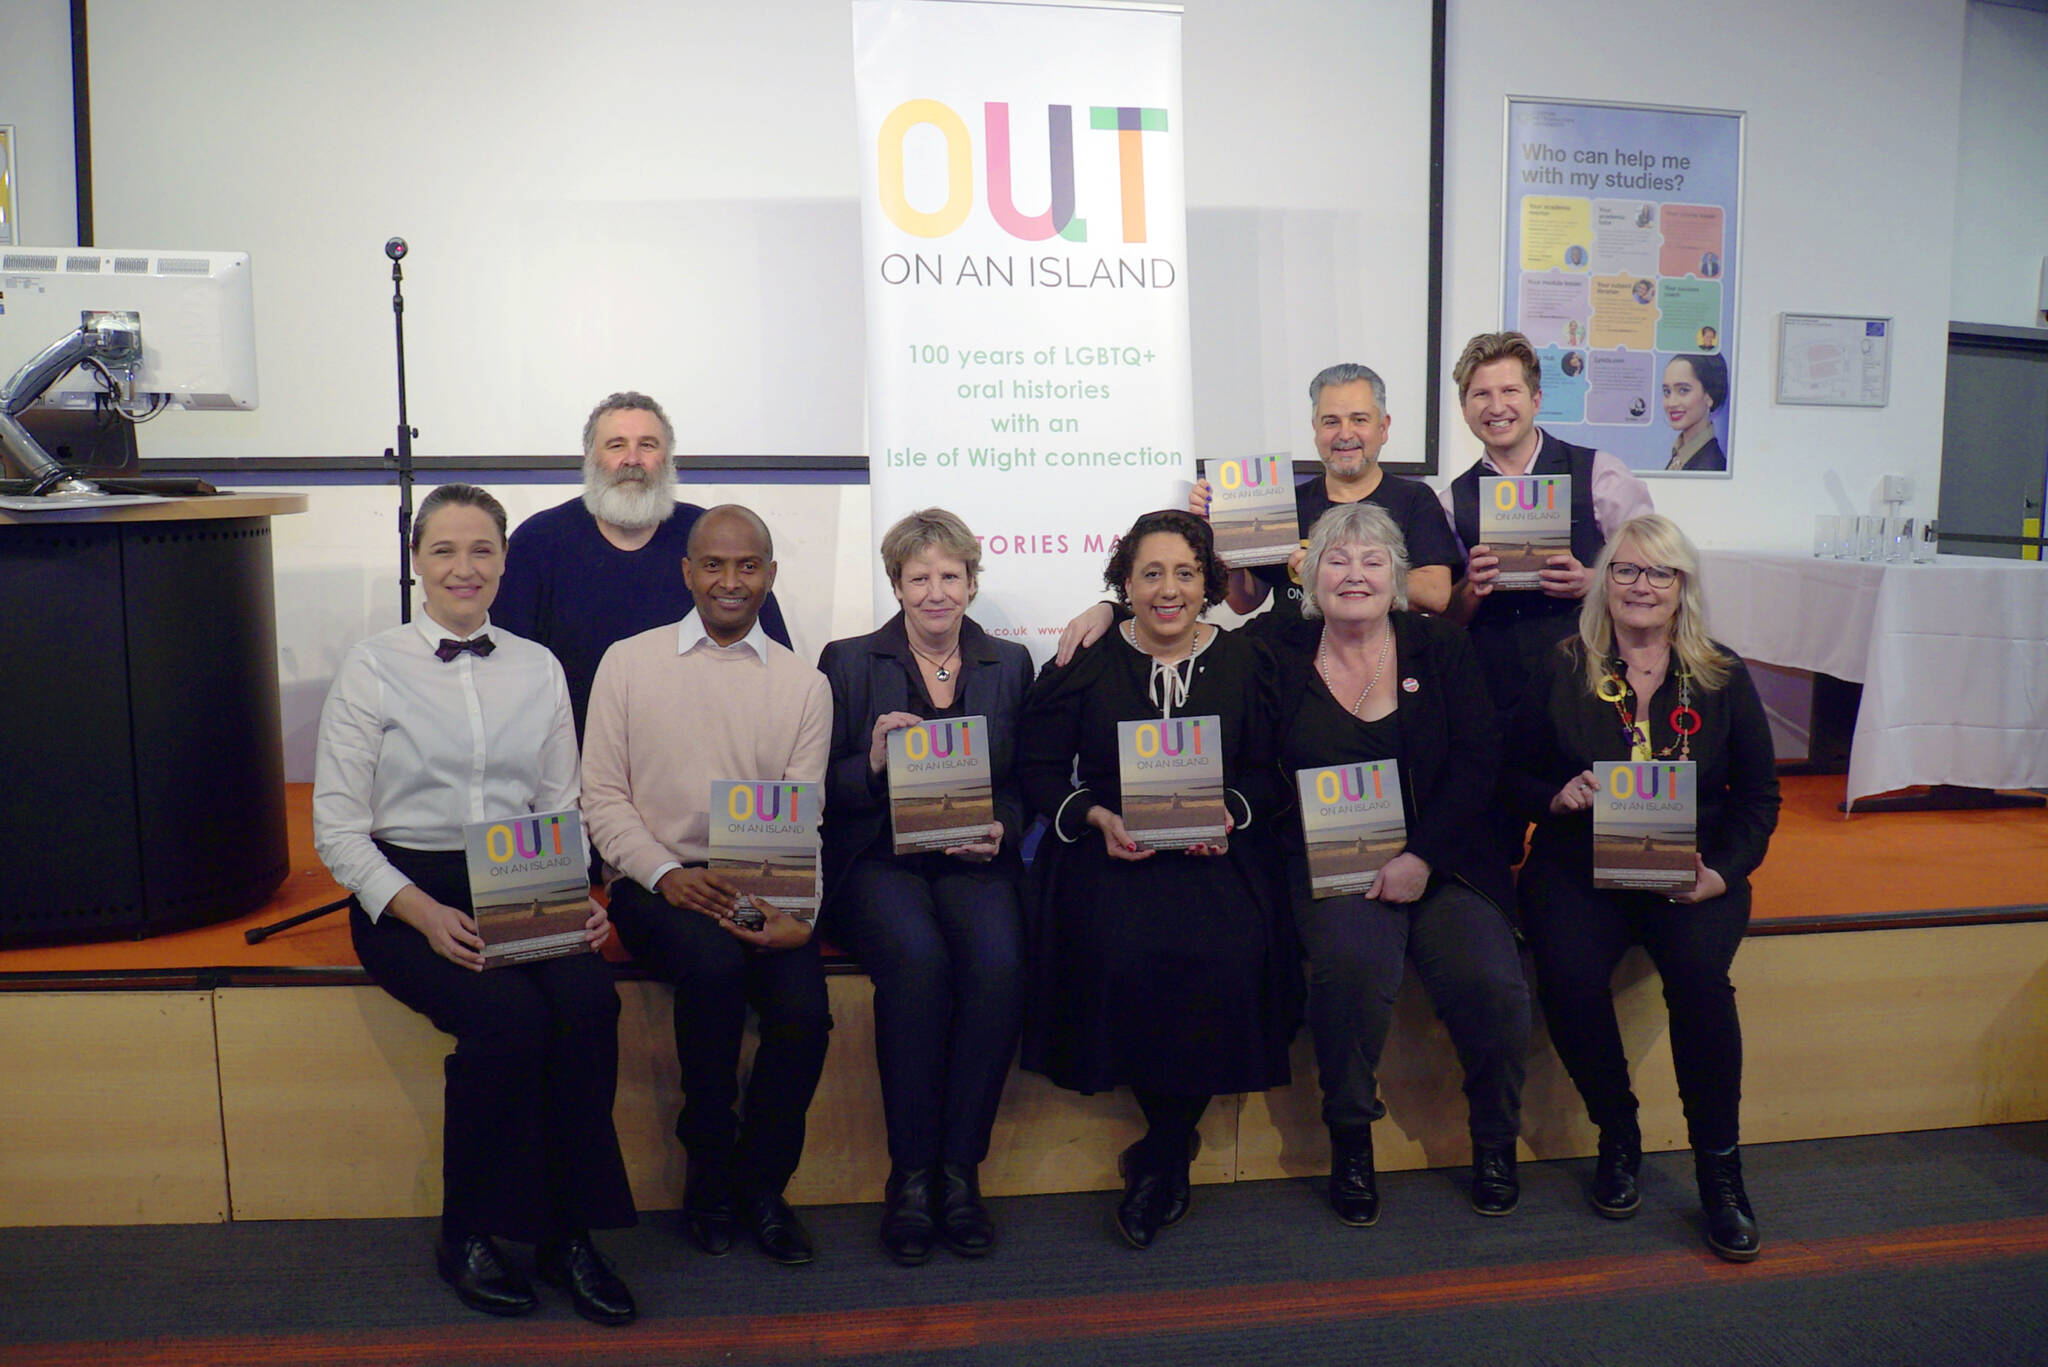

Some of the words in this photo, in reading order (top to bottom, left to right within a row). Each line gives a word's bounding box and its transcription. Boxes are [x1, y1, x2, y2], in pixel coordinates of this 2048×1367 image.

[1521, 143, 1567, 163] Who
[1573, 149, 1608, 165] can
[1615, 148, 1656, 170] help
[1662, 155, 1690, 170] me
[877, 98, 1168, 243] OUT
[1522, 167, 1563, 185] with
[1570, 173, 1599, 190] my
[1605, 172, 1684, 191] studies?
[881, 252, 942, 285] ON
[956, 255, 1013, 287] AN
[1029, 256, 1176, 289] ISLAND
[908, 345, 951, 365] 100
[958, 347, 1025, 369] years
[1033, 345, 1057, 365] of
[1064, 347, 1157, 367] LGBTQ+
[957, 380, 1004, 400] oral
[1013, 378, 1111, 400] histories
[990, 413, 1040, 433] with
[1049, 417, 1079, 433] an
[886, 448, 927, 468] Isle
[937, 448, 960, 467] of
[967, 448, 1036, 472] Wight
[1045, 446, 1183, 467] connection
[1219, 455, 1282, 491] OUT
[1495, 479, 1561, 511] OUT
[974, 535, 1069, 554] TORIES
[985, 626, 1028, 637] s.co.uk
[905, 721, 976, 761] OUT
[1135, 720, 1207, 758] OUT
[907, 763, 924, 773] ON
[925, 761, 941, 771] AN
[942, 758, 978, 769] ISLAND
[1136, 760, 1154, 770] ON
[1155, 759, 1170, 768] AN
[1172, 756, 1209, 767] ISLAND
[1315, 763, 1386, 804] OUT
[1609, 765, 1684, 800] OUT
[728, 784, 806, 822] OUT
[1320, 806, 1336, 816] ON
[1338, 805, 1353, 814] AN
[1353, 800, 1391, 813] ISLAND
[1610, 802, 1626, 811] ON
[1628, 802, 1644, 811] AN
[1646, 802, 1684, 811] ISLAND
[485, 816, 566, 863] OUT
[728, 823, 745, 833] ON
[748, 824, 763, 833] AN
[765, 824, 805, 834] ISLAND
[490, 865, 508, 877] ON
[511, 862, 528, 874] AN
[530, 856, 572, 870] ISLAND
